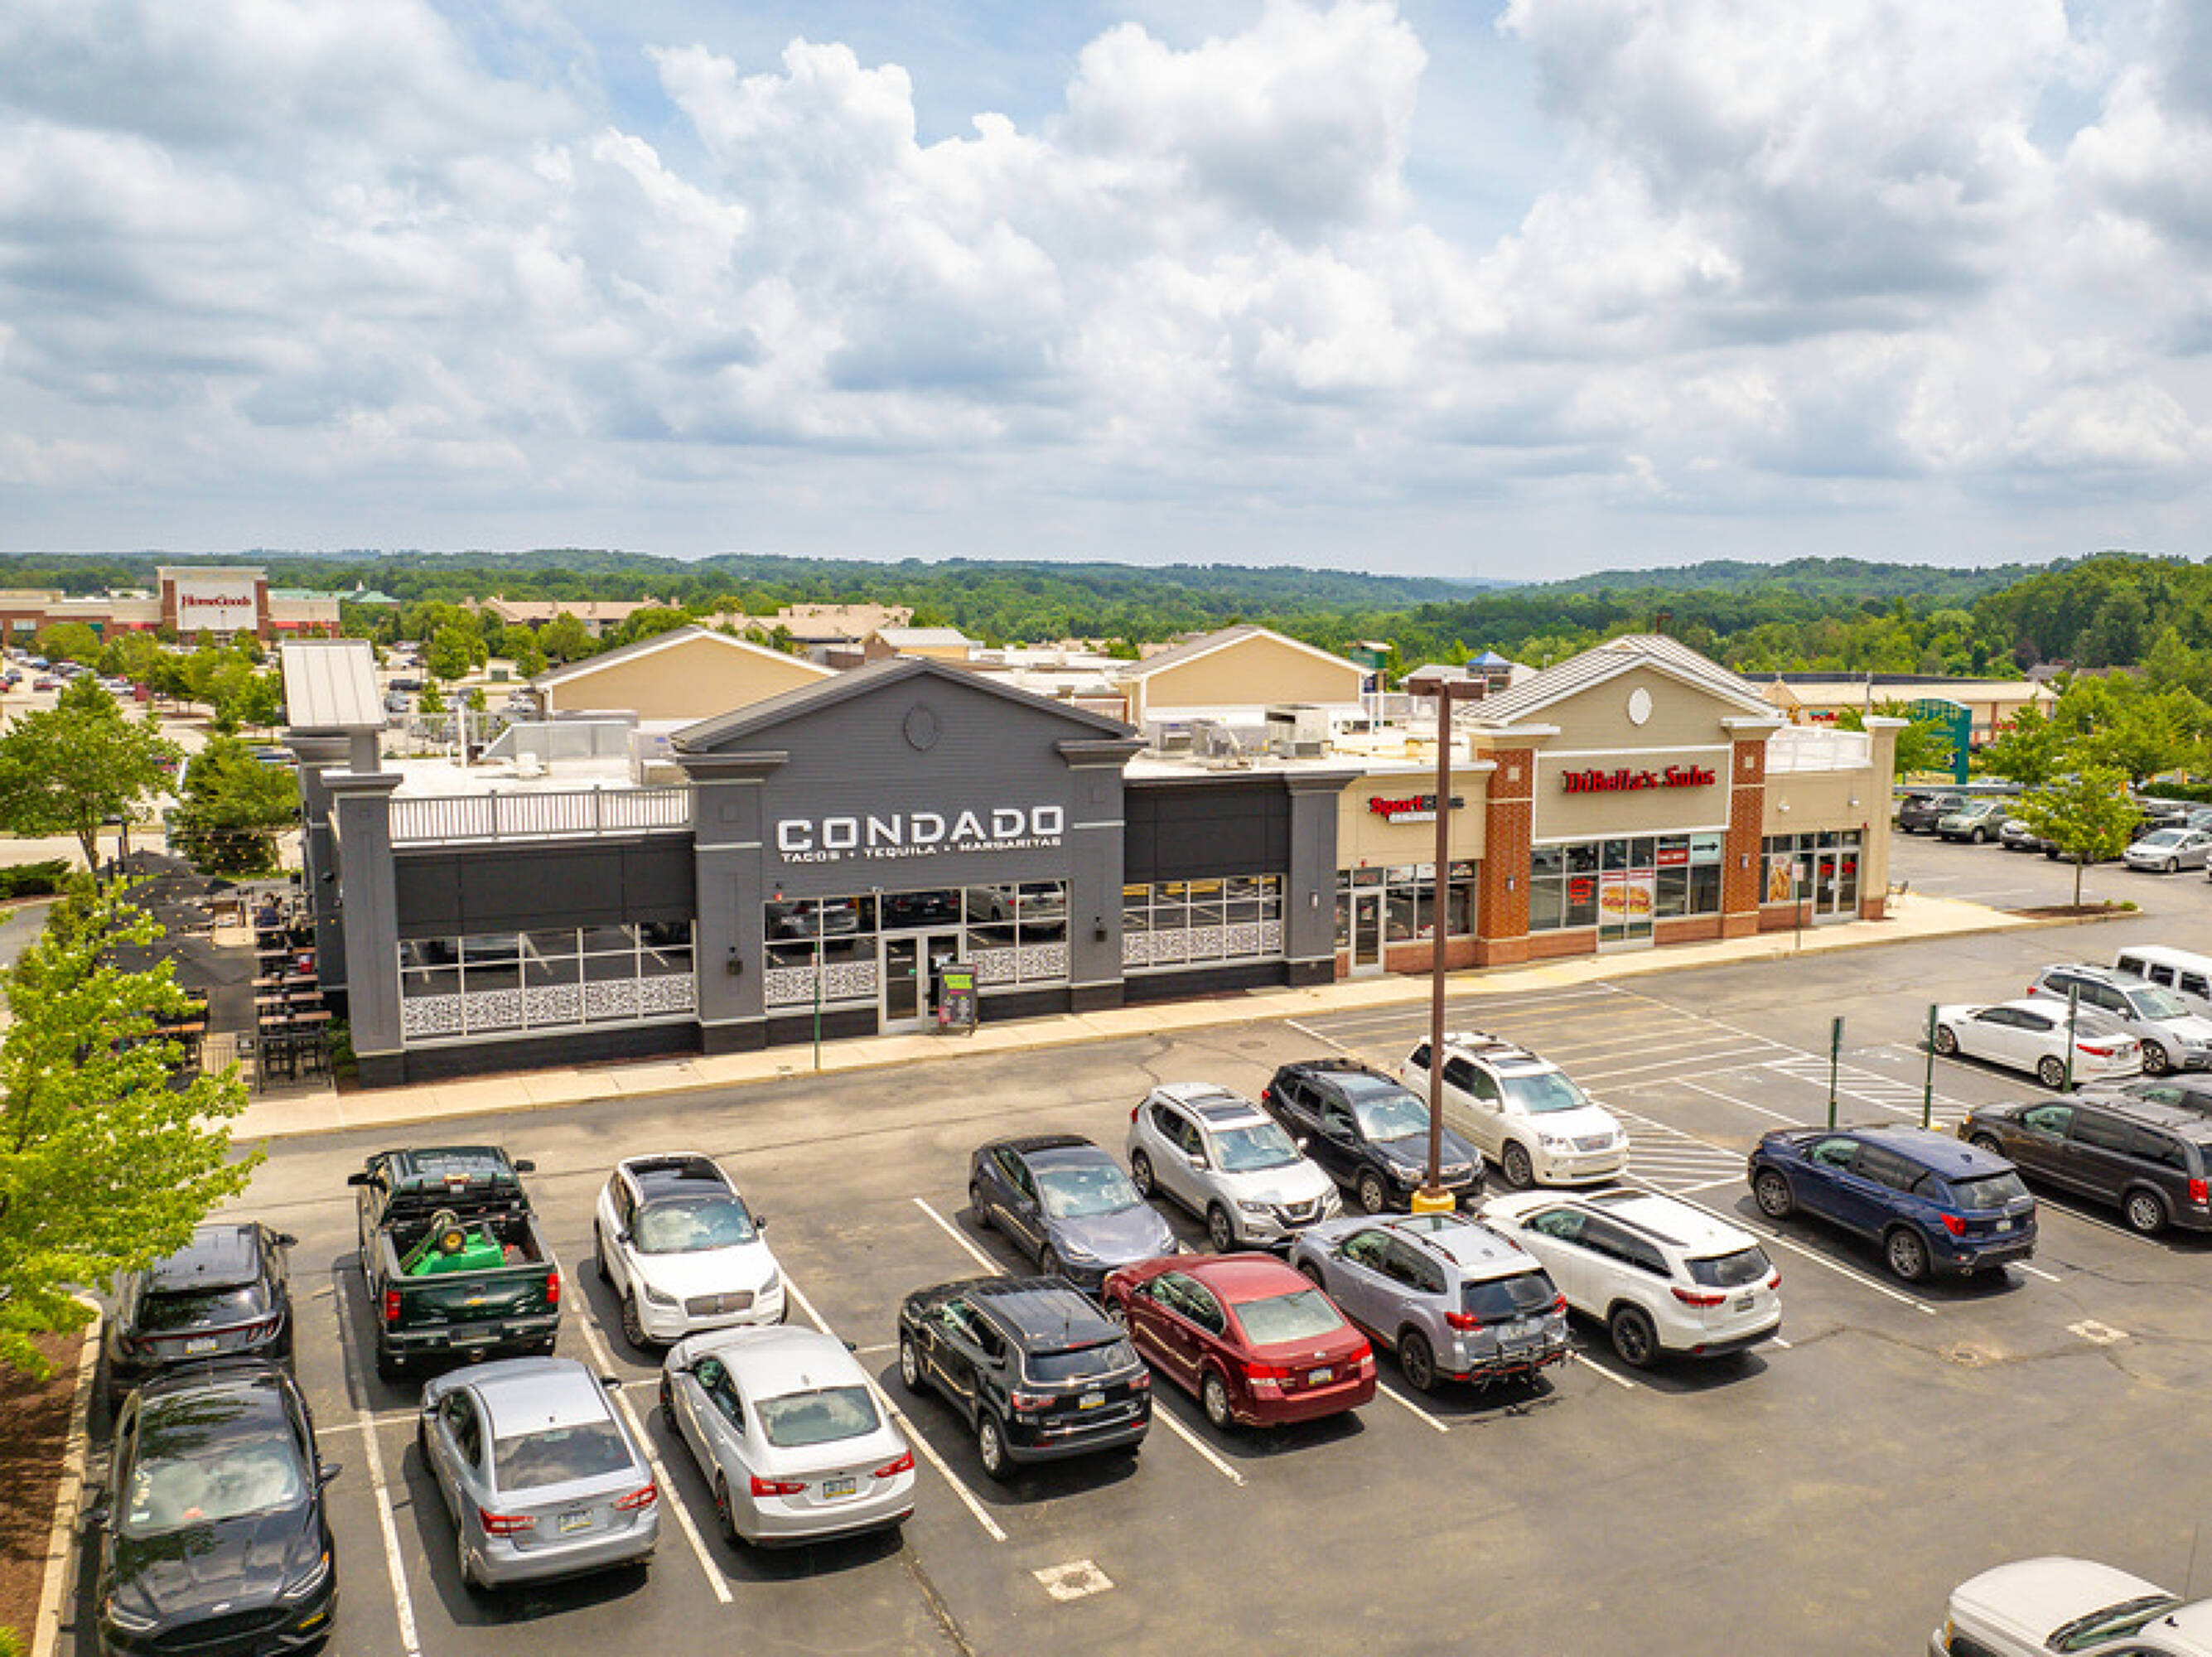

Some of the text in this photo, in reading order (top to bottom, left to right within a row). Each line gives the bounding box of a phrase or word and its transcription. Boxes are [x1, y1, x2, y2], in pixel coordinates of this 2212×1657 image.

[181, 594, 252, 606] HomeGoods
[1562, 764, 1715, 793] DiBella's Subs
[1369, 795, 1422, 819] Sport
[777, 806, 1064, 852] CONDADO
[781, 850, 841, 862] TACOS
[864, 844, 937, 859] TEQUILA
